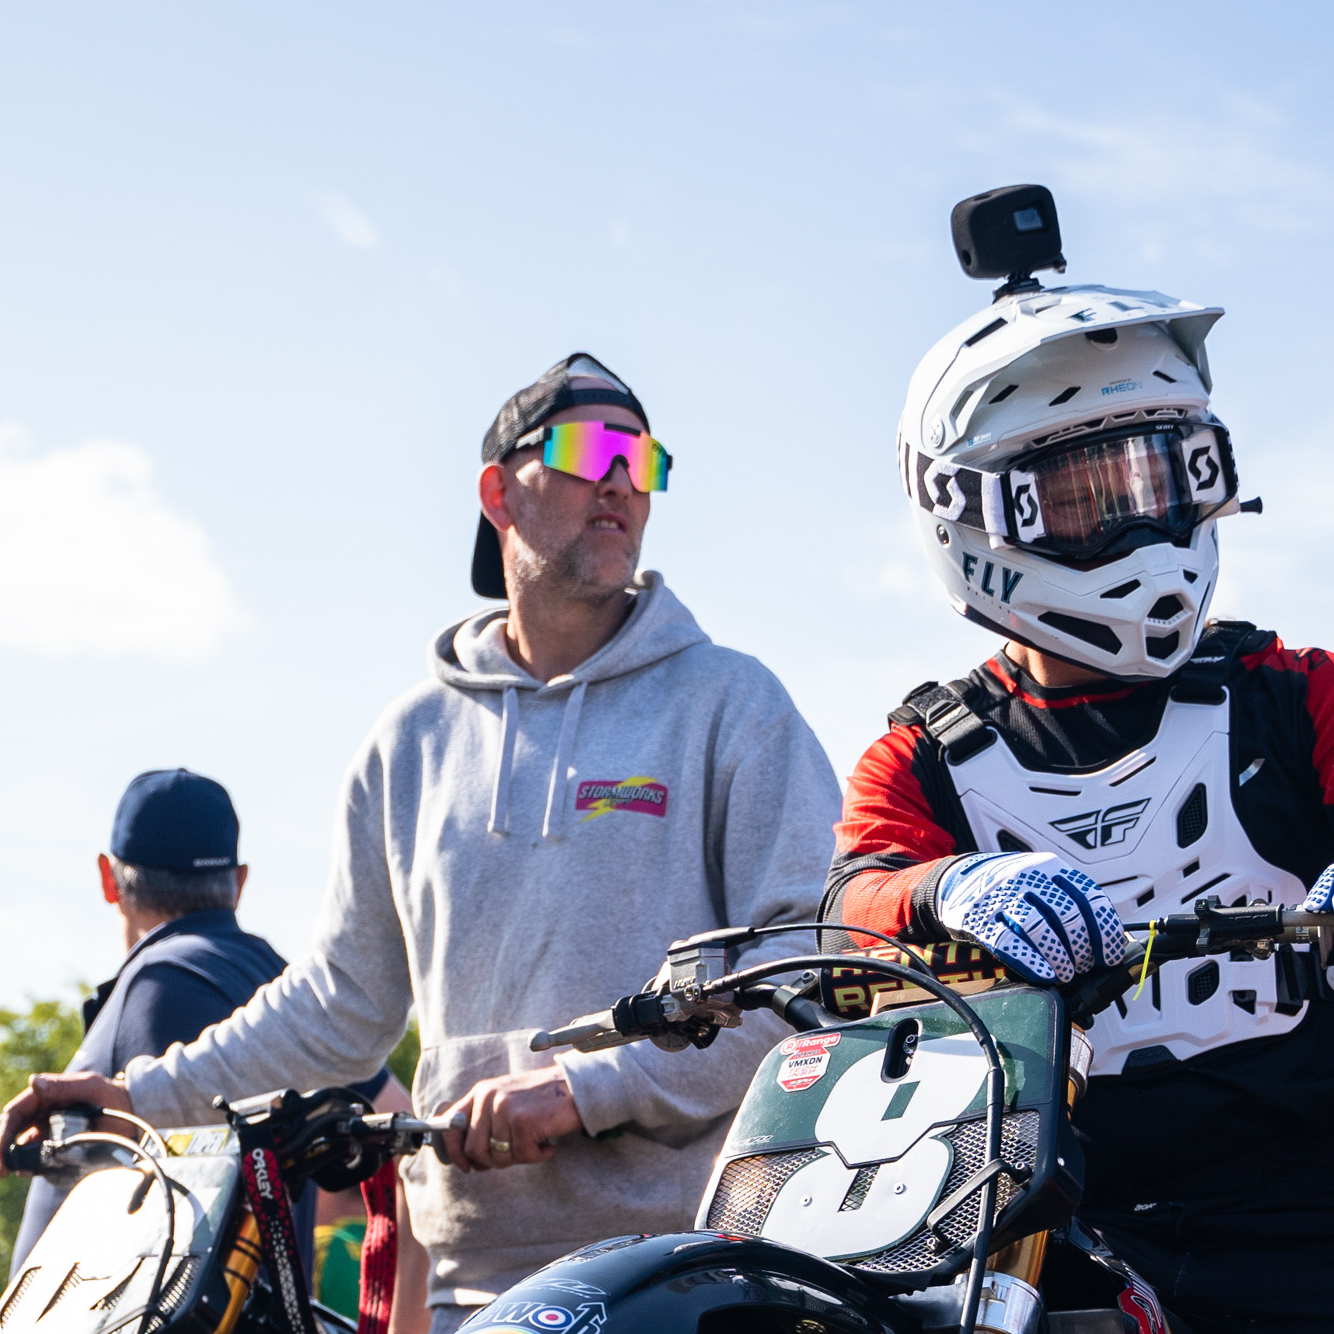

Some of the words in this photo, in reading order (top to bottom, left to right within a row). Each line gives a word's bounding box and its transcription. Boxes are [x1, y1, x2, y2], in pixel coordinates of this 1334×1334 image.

[1101, 380, 1144, 397] RHEON
[961, 551, 1024, 604] FLY
[578, 785, 666, 805] STORMWORKS
[788, 1056, 823, 1068] VMXDN
[761, 1032, 998, 1261] 8
[251, 1147, 274, 1200] OAKLEY
